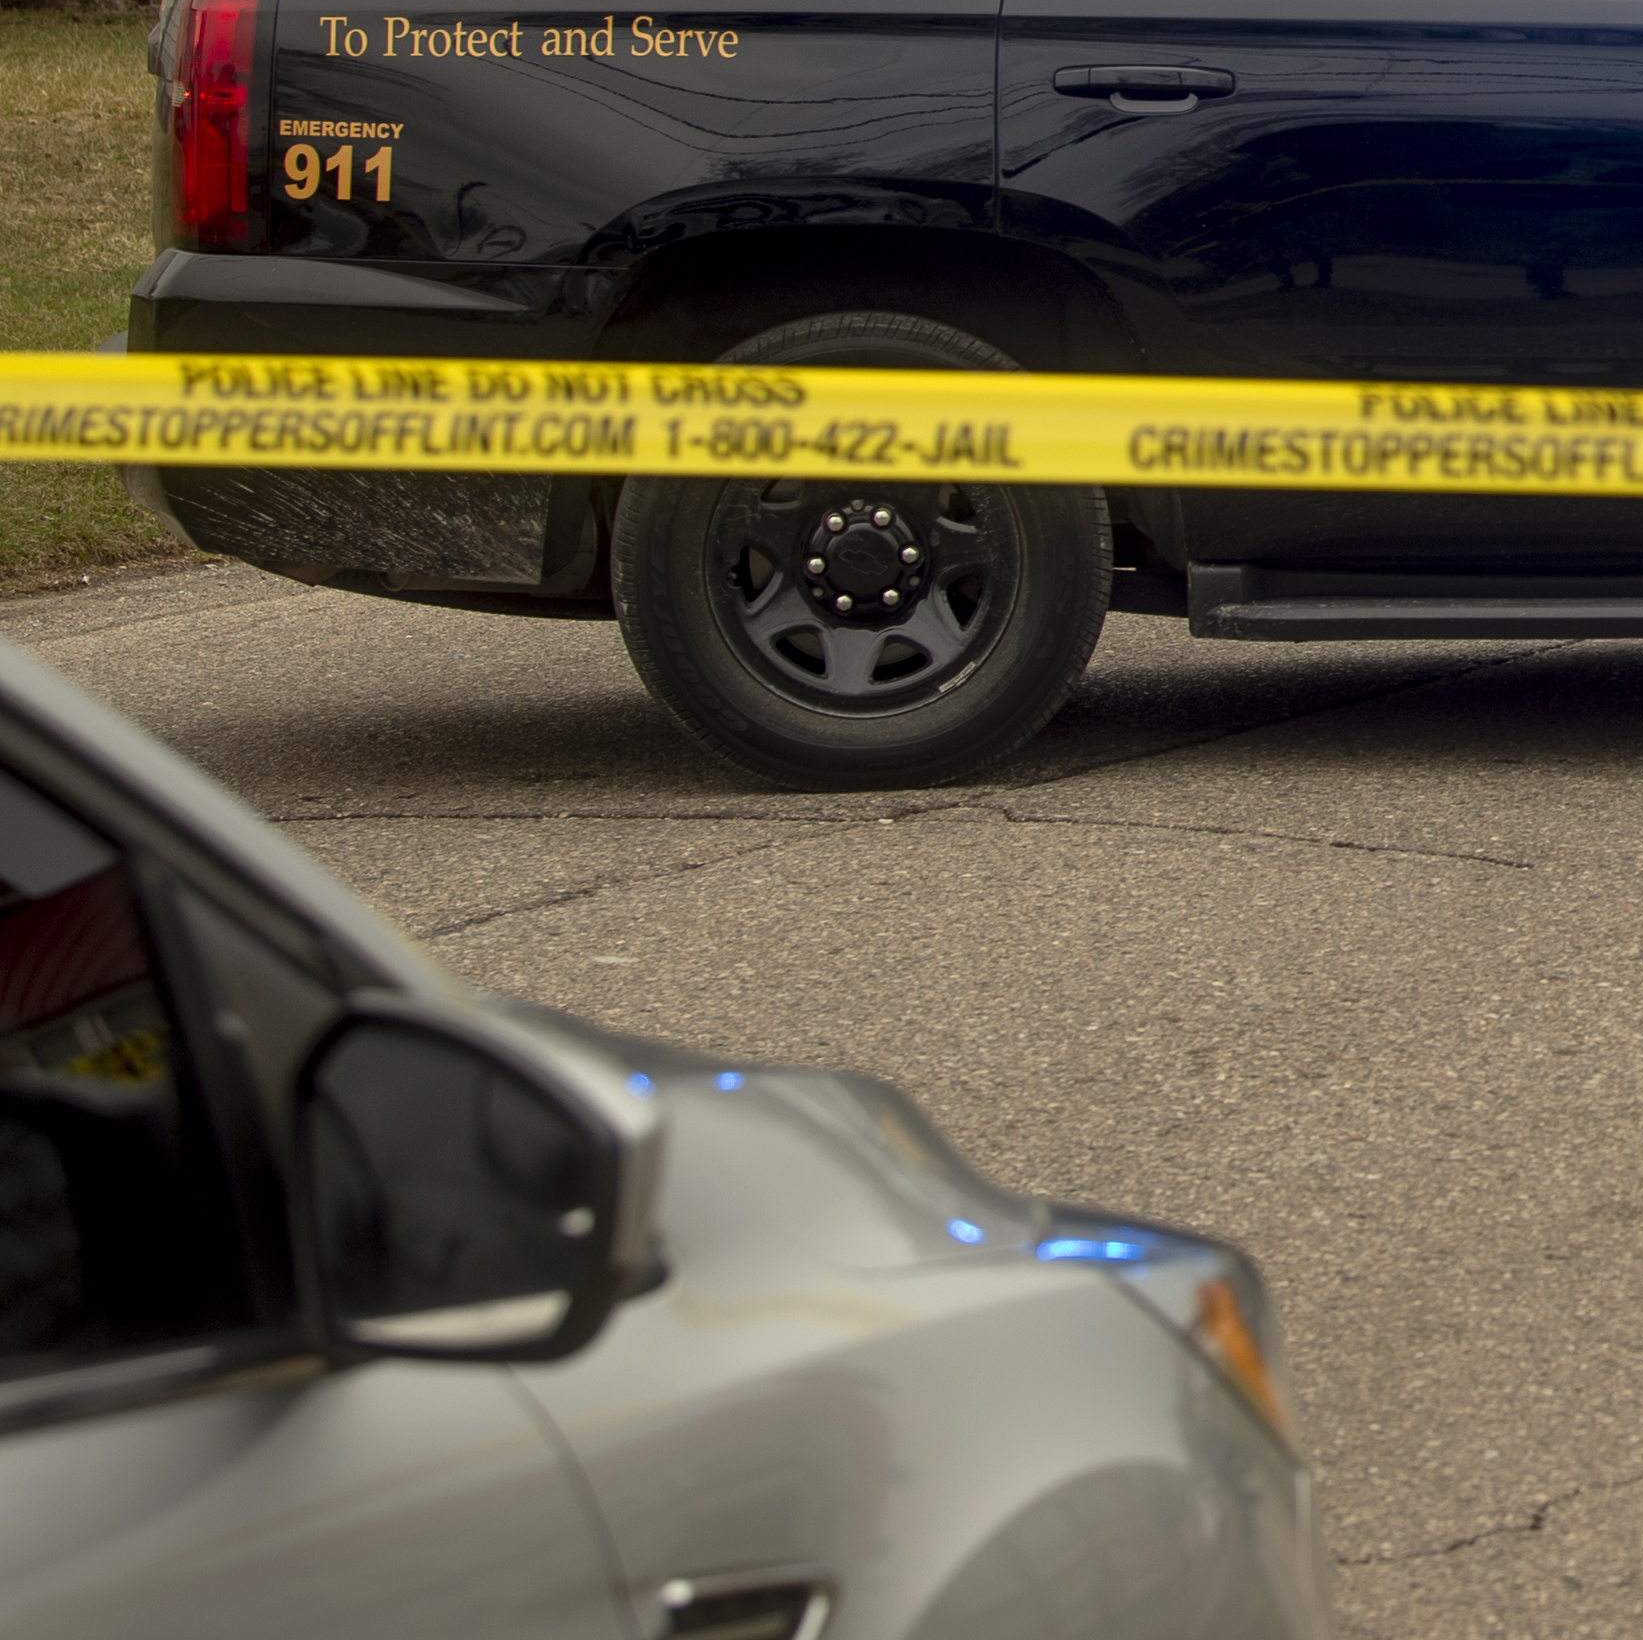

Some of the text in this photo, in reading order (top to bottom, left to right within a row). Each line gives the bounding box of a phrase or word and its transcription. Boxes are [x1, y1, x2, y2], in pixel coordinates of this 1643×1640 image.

[320, 15, 740, 59] To Protect and Serve
[279, 120, 404, 140] EMERGENCY
[284, 144, 394, 202] 911
[179, 361, 336, 400] POLICE
[353, 363, 450, 402] LINE
[468, 367, 530, 405] DO
[545, 368, 632, 405] NOT
[0, 401, 1024, 469] RIMESTOPPERSOFFLINT.COM 1-800-422-JAIL
